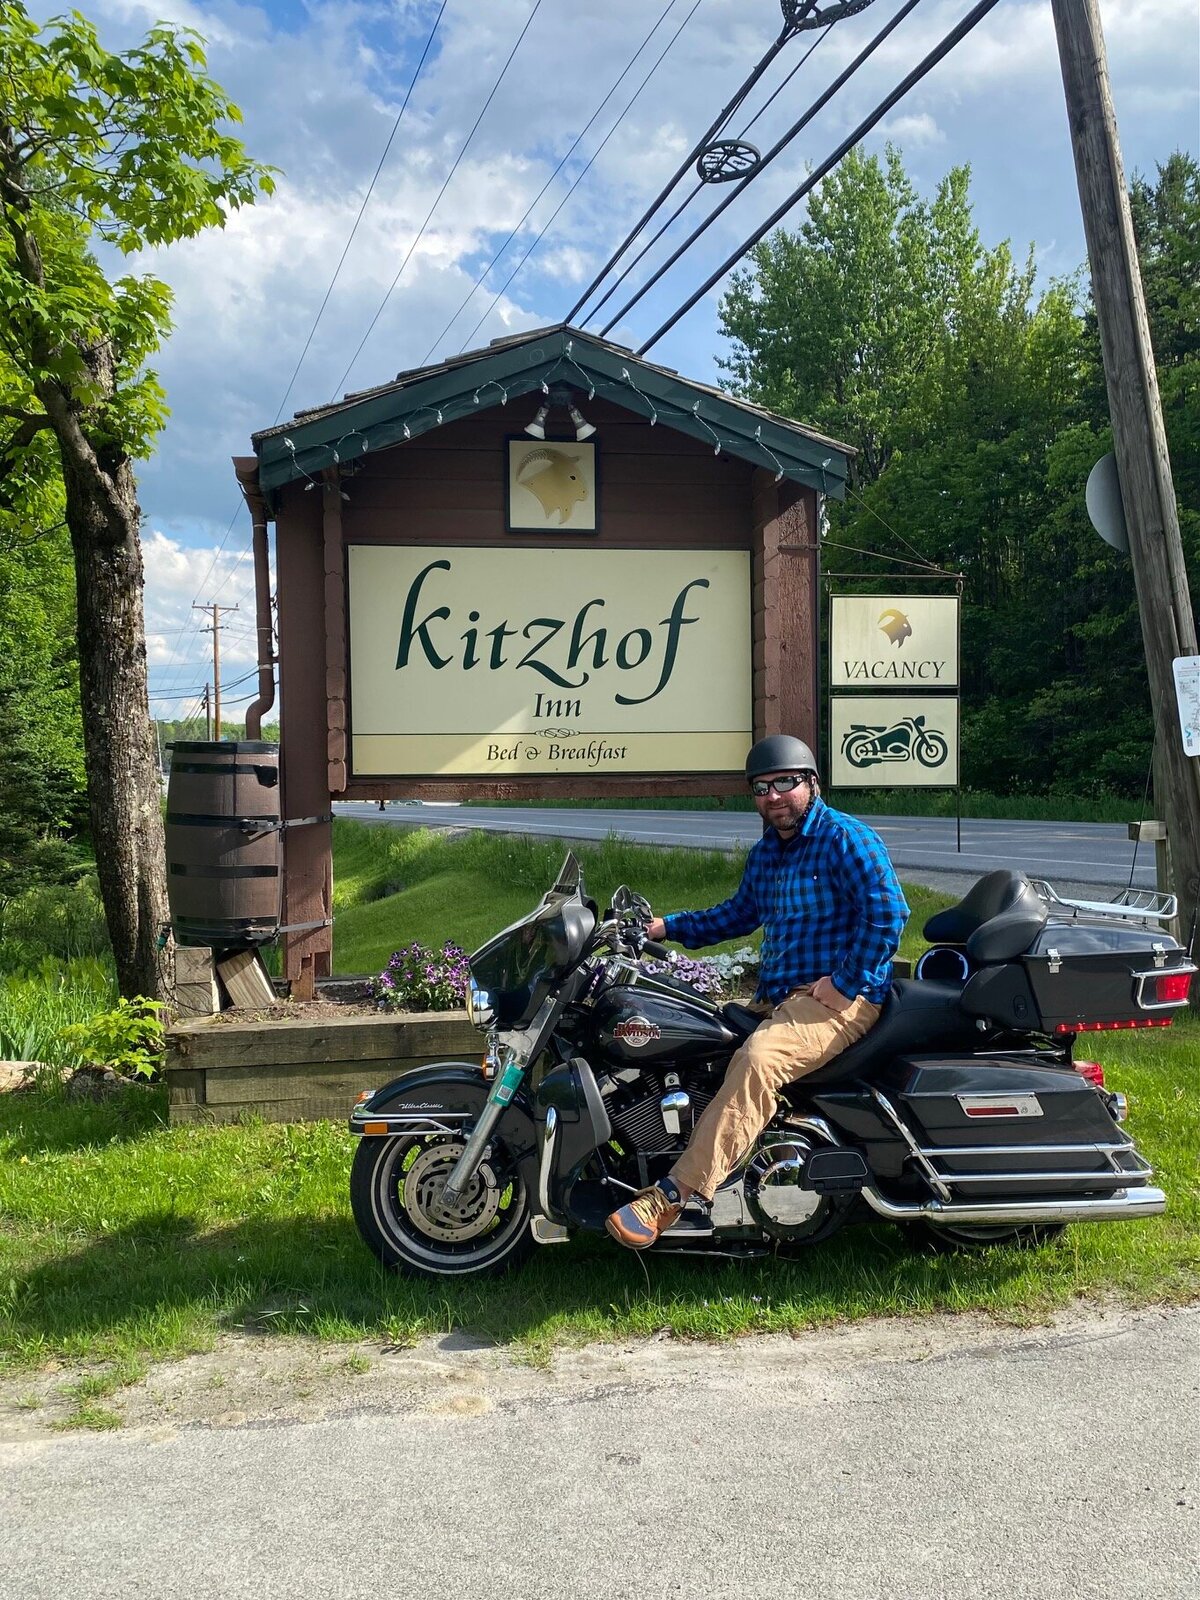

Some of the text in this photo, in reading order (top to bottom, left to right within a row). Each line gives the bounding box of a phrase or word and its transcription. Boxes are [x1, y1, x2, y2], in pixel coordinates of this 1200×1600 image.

[395, 560, 710, 705] kitzhof
[843, 661, 946, 679] VACANCY
[532, 692, 581, 717] Inn
[486, 740, 627, 767] Bed & Breakfast
